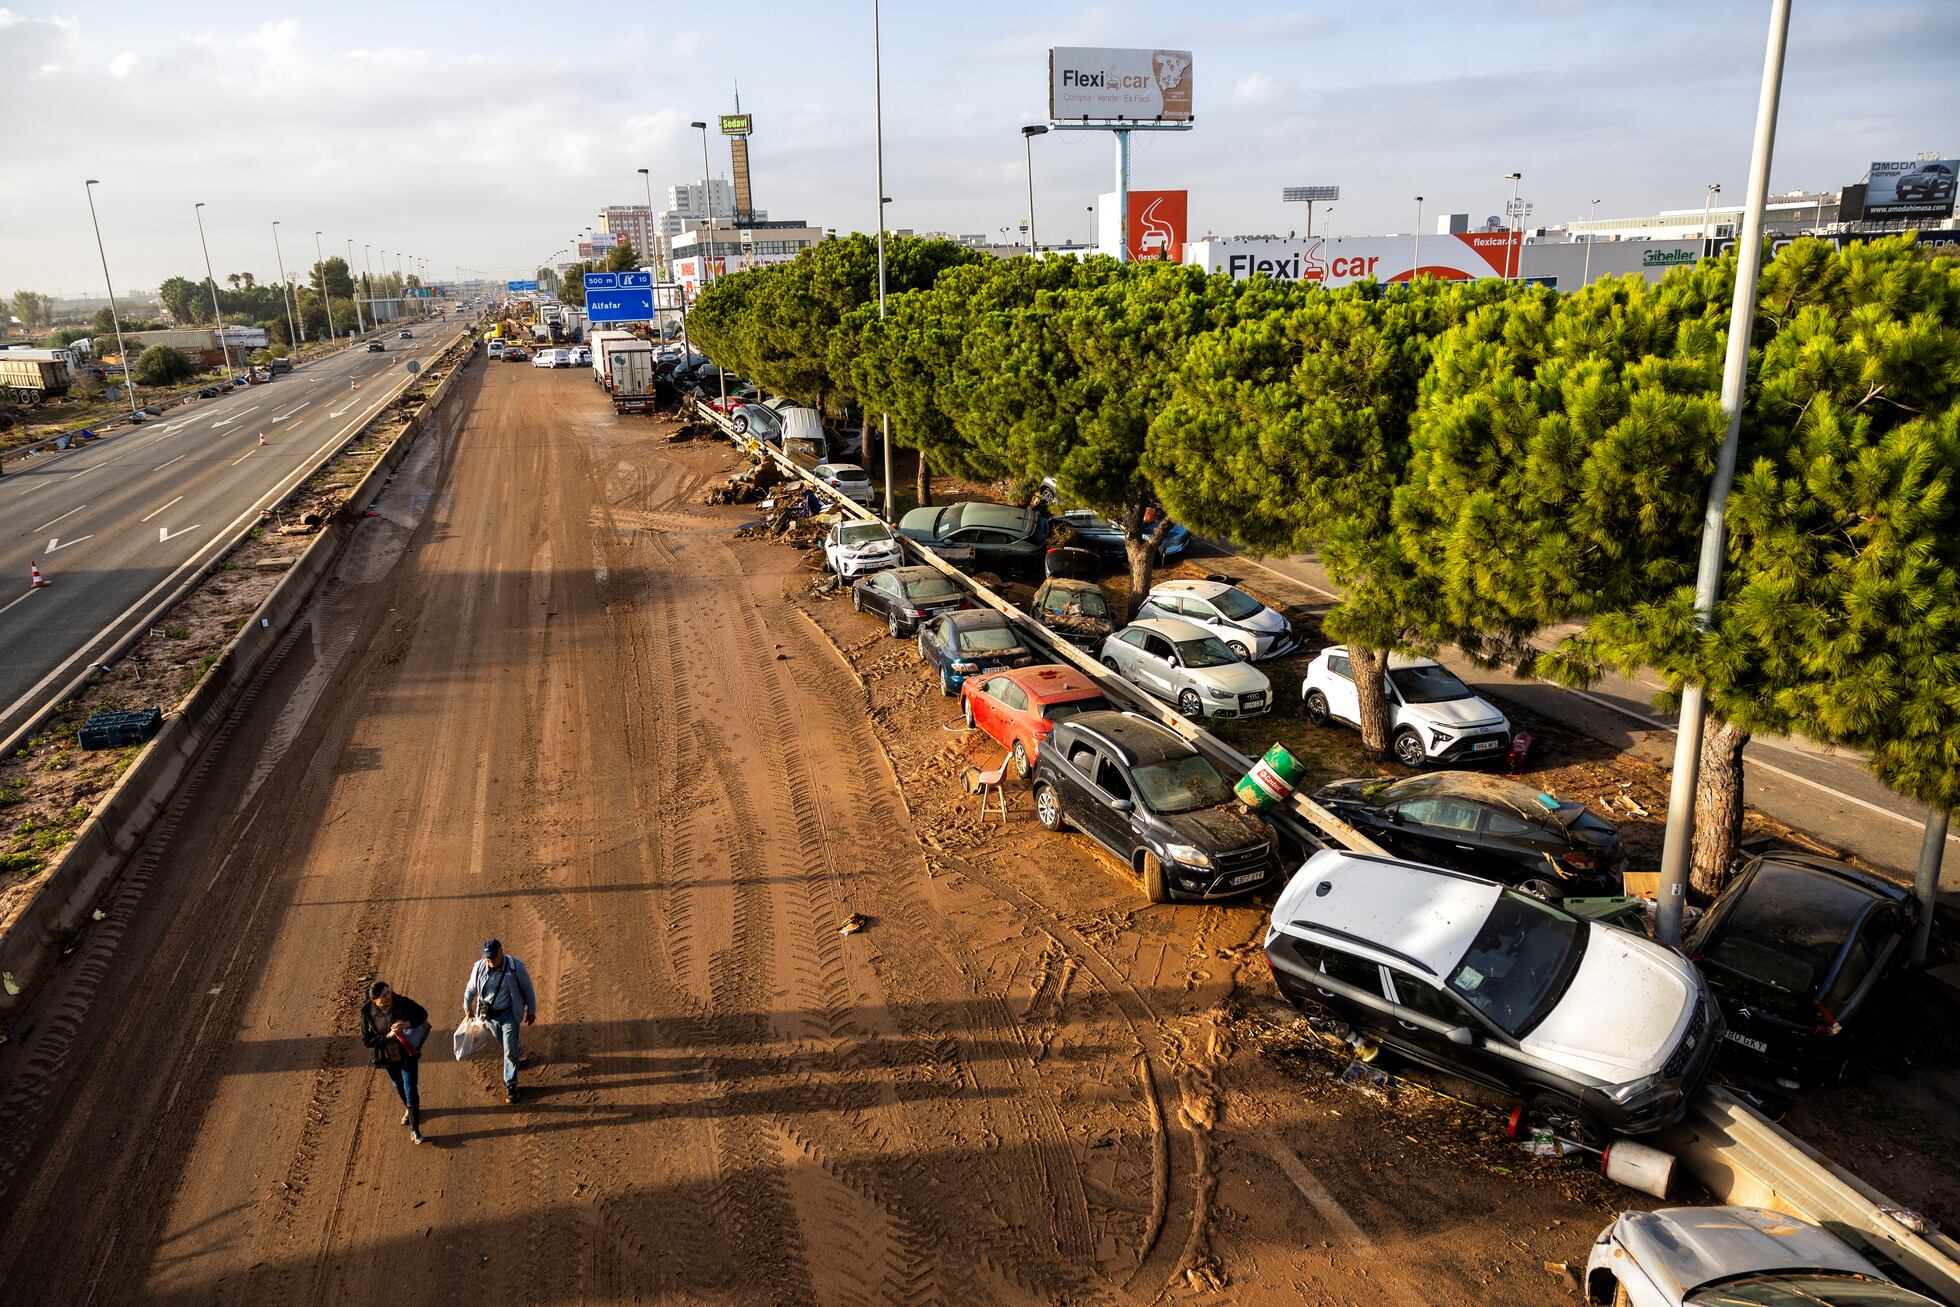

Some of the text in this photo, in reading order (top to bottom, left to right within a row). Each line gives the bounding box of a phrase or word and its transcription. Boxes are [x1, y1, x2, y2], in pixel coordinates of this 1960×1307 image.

[1063, 70, 1150, 88] Flexi car
[1872, 162, 1916, 171] OMODA
[1870, 204, 1946, 213] www.omodahimasa.com
[1643, 249, 1695, 261] Gibeller
[1229, 253, 1379, 281] Flexi car
[591, 302, 621, 310] Alfafar
[1265, 775, 1284, 793] Castrol
